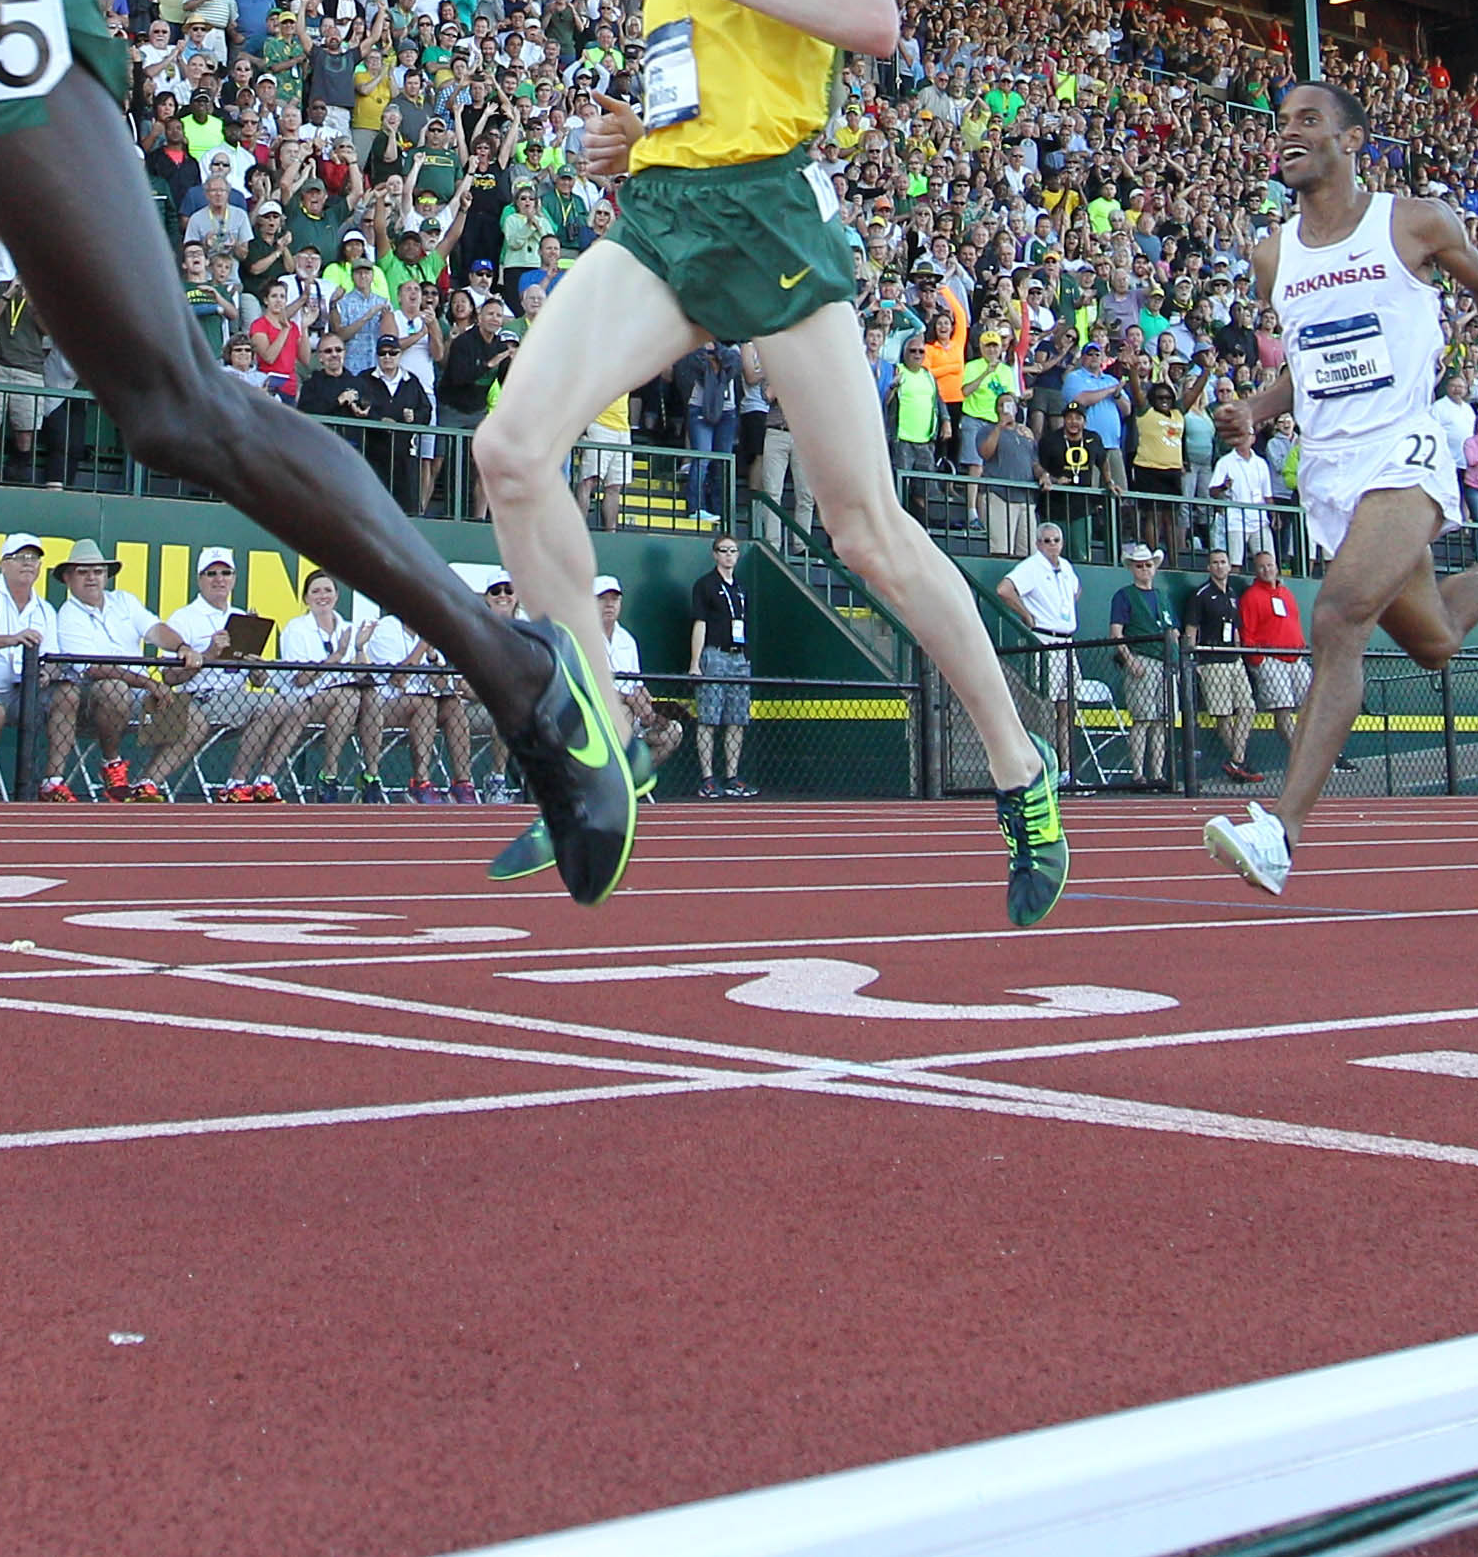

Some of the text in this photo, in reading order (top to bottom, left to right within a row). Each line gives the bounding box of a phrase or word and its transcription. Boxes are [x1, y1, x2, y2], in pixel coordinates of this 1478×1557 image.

[1283, 264, 1387, 301] ARKANSAS
[1315, 360, 1378, 384] Campbell
[1322, 348, 1358, 364] Kemoy
[1405, 433, 1437, 470] 22
[492, 957, 1180, 1020] 2
